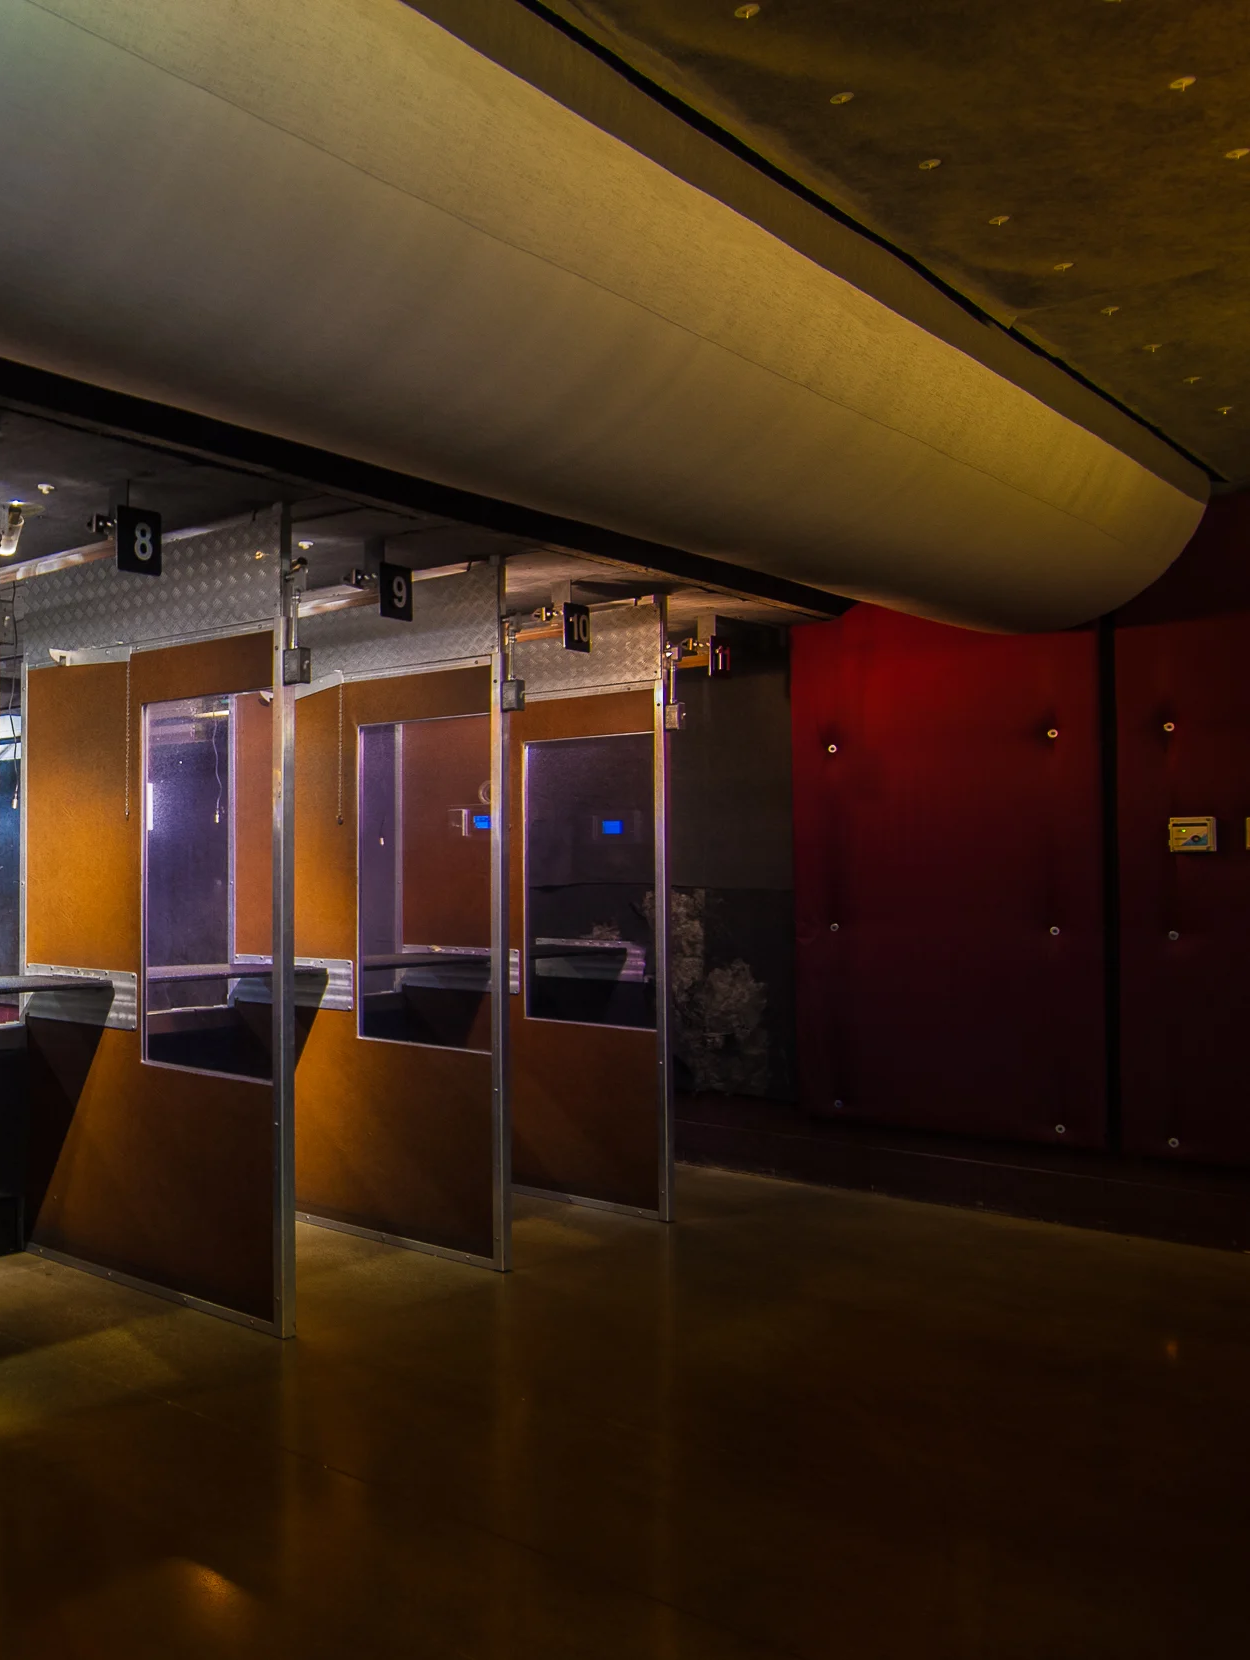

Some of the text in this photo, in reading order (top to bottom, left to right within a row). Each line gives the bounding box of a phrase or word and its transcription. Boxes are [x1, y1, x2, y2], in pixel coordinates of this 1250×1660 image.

[134, 522, 153, 561] 8
[393, 576, 407, 608] 9
[570, 613, 590, 642] 10
